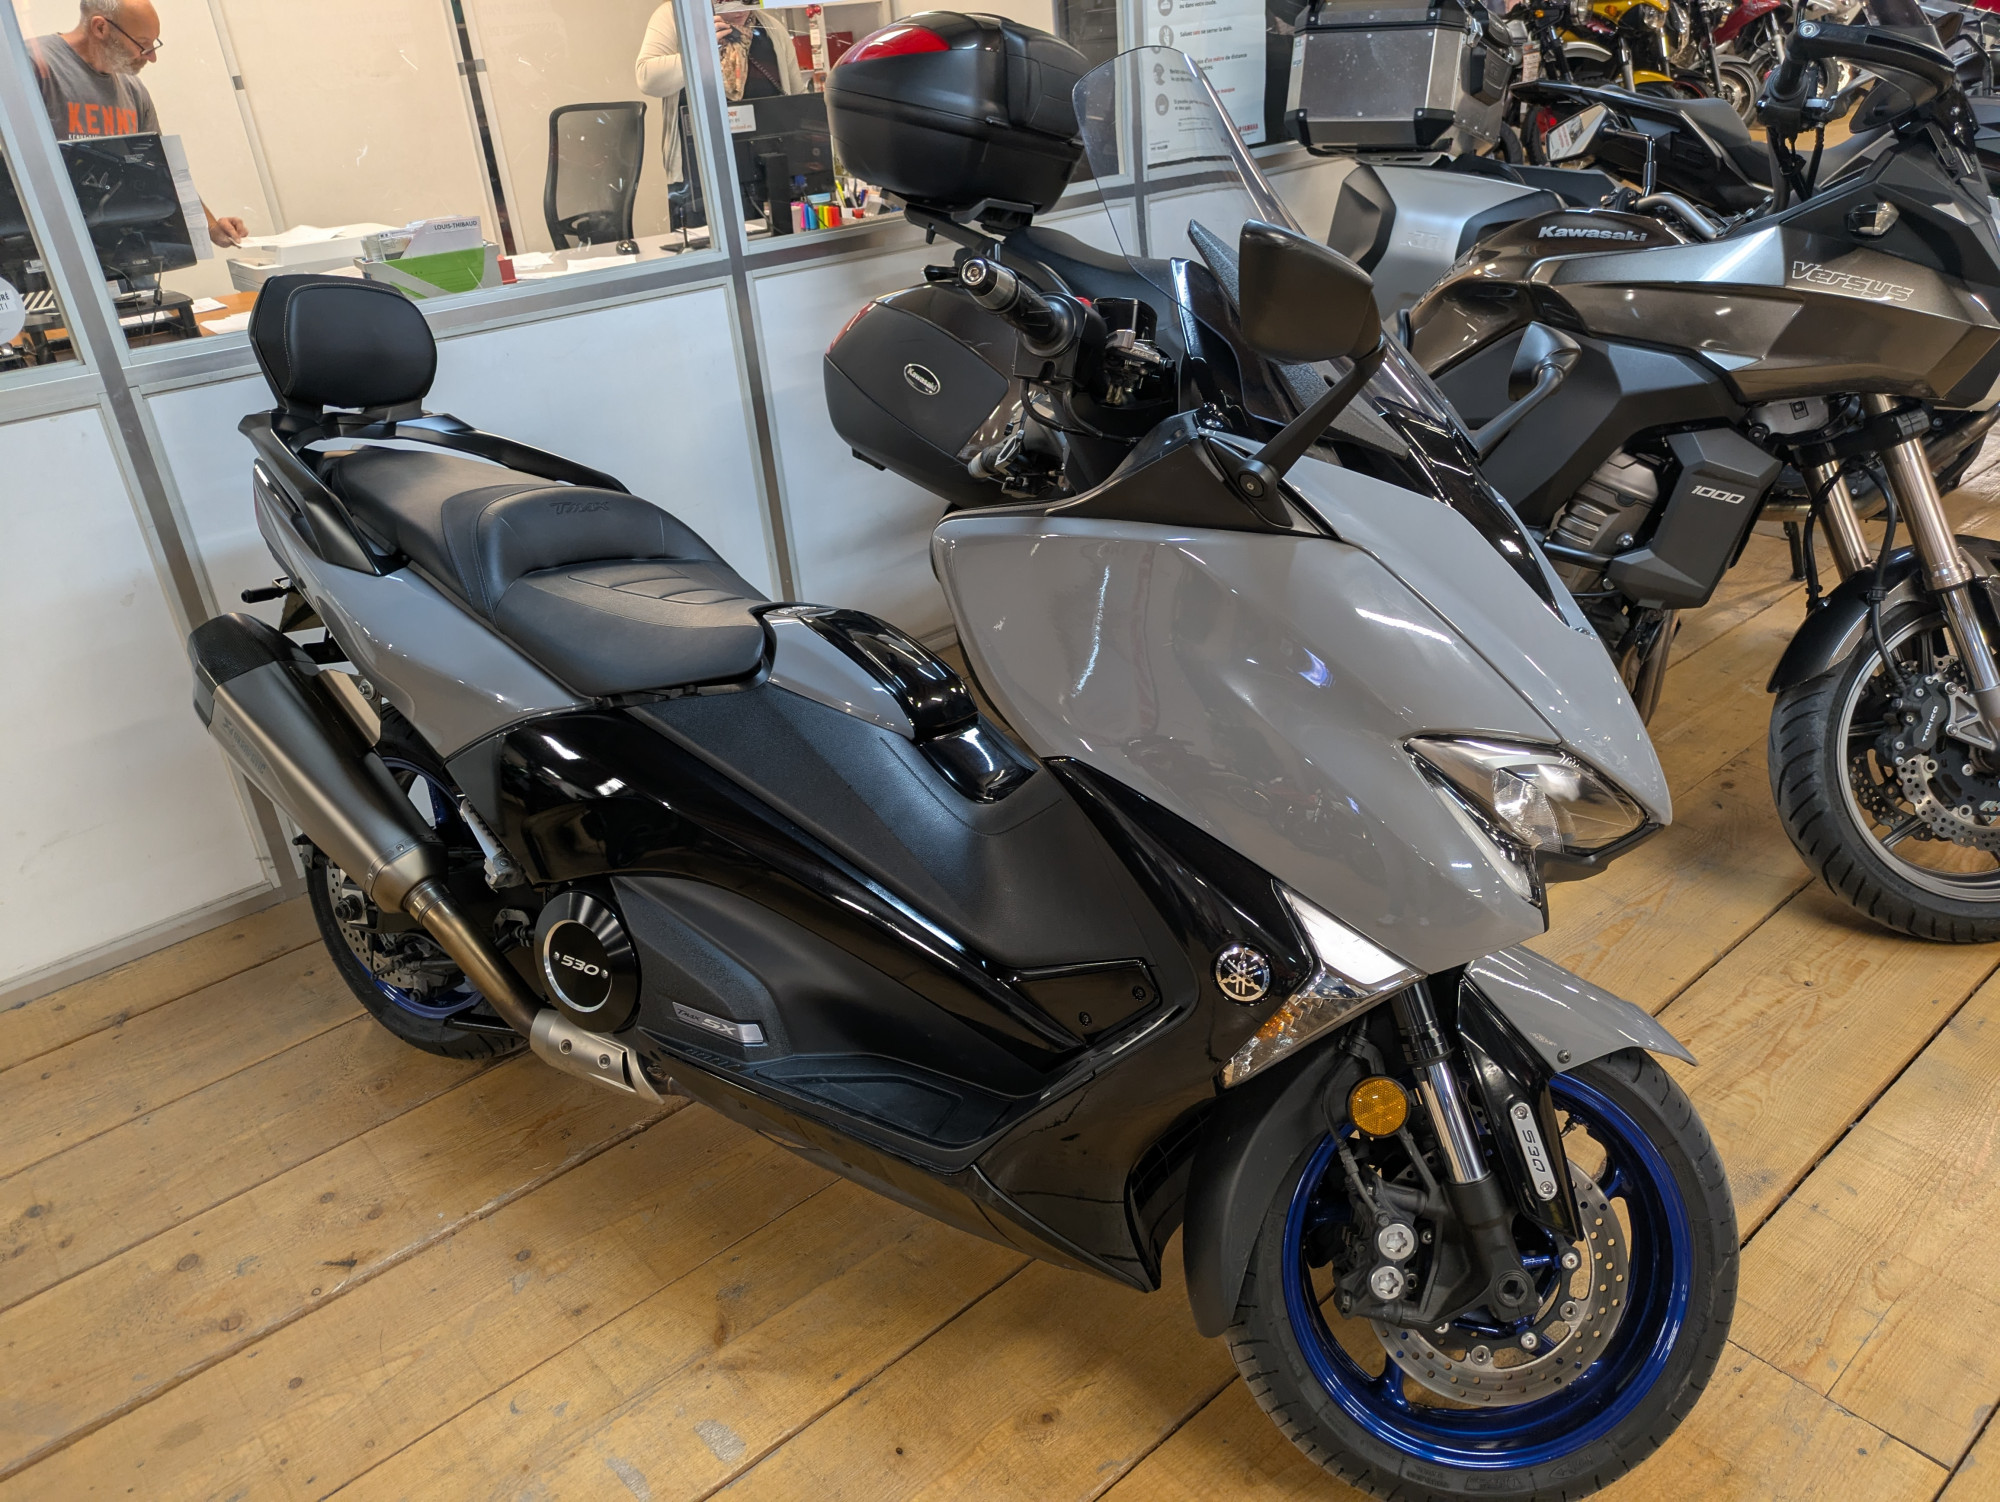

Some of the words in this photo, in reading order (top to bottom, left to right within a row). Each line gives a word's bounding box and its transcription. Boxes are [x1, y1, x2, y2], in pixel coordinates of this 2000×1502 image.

[434, 220, 478, 231] LOUIS-THIBAUD
[1537, 225, 1648, 242] Kawasaki
[1691, 485, 1746, 505] 1000
[1921, 705, 1939, 743] TOKICO
[560, 954, 600, 976] 530
[701, 1018, 737, 1036] SX
[1521, 1129, 1547, 1173] 530
